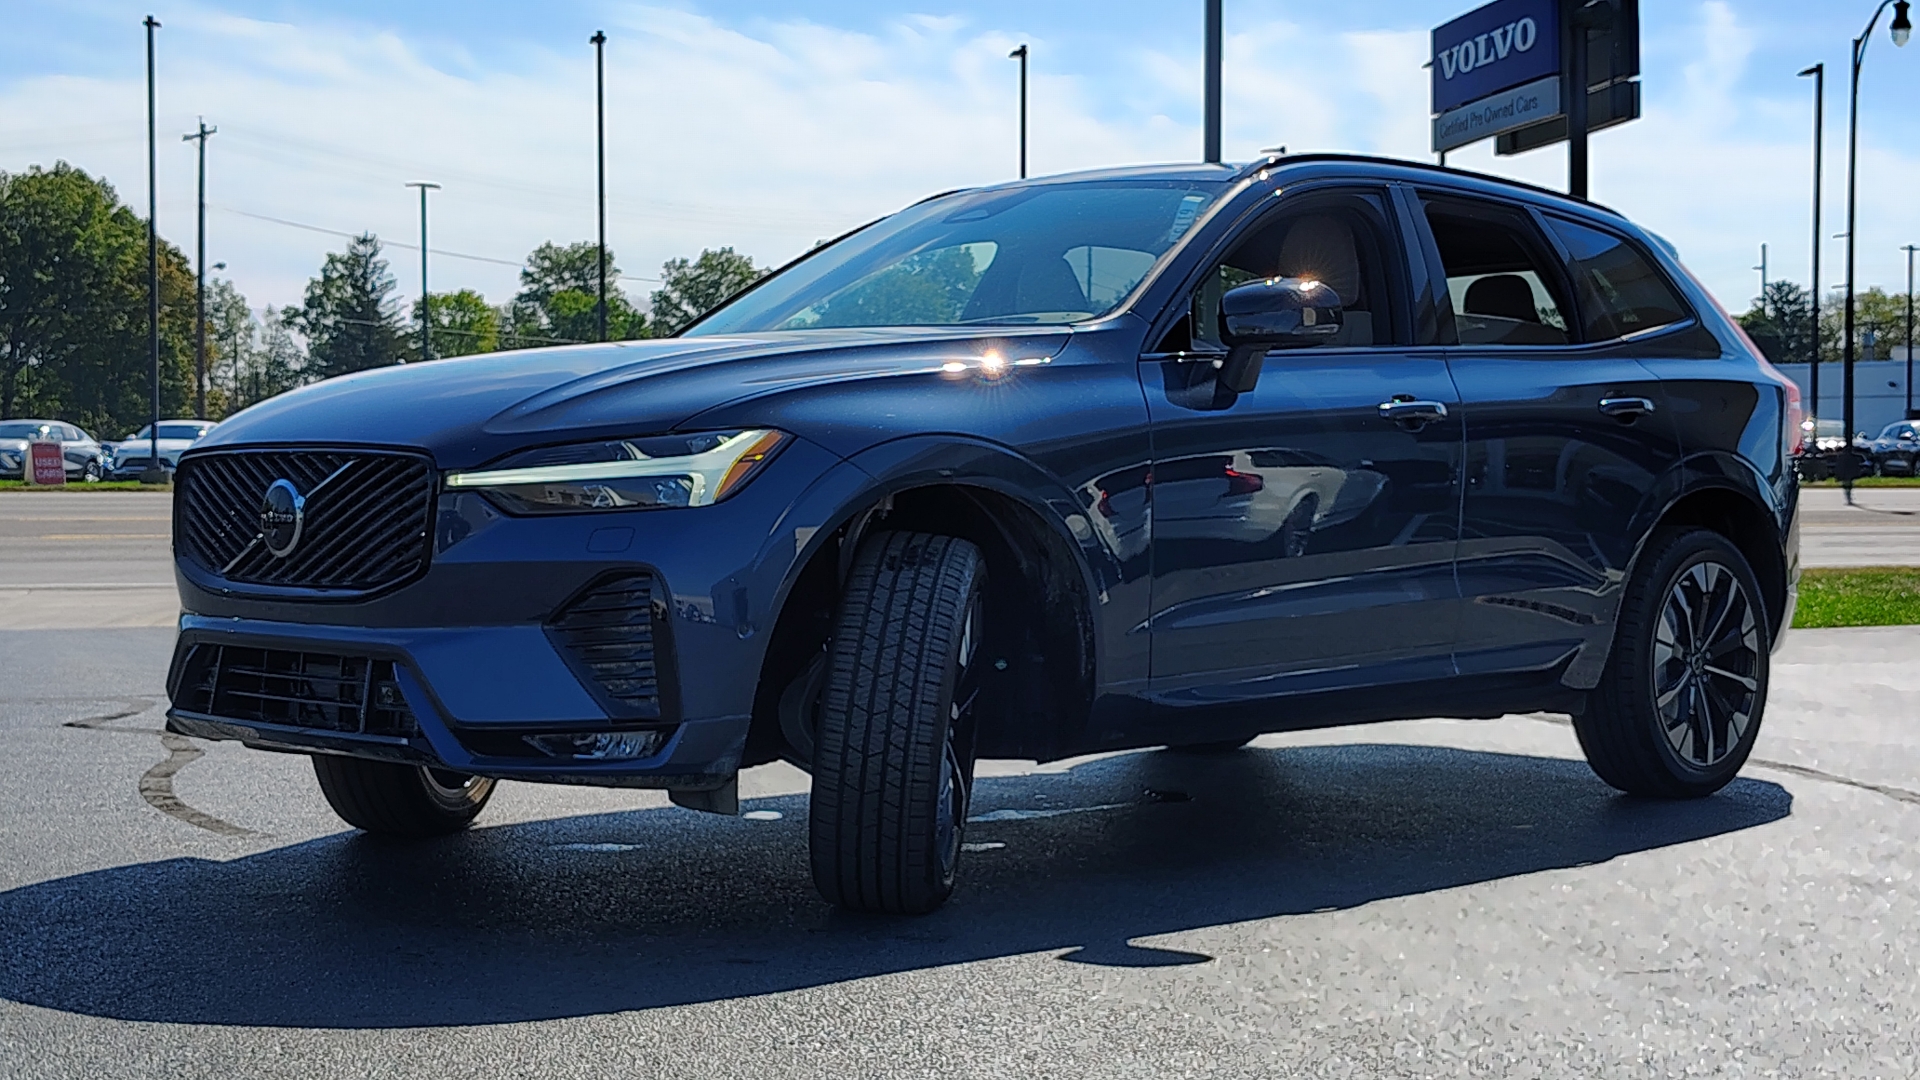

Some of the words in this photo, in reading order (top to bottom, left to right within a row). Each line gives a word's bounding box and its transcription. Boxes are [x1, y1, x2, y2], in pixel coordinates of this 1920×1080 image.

[1438, 17, 1536, 80] VOLVO
[1440, 114, 1469, 139] Certified
[1470, 112, 1483, 128] Pre
[1484, 99, 1514, 123] Owned
[1516, 96, 1538, 114] Cars
[35, 457, 61, 467] USED
[36, 468, 64, 479] CARS
